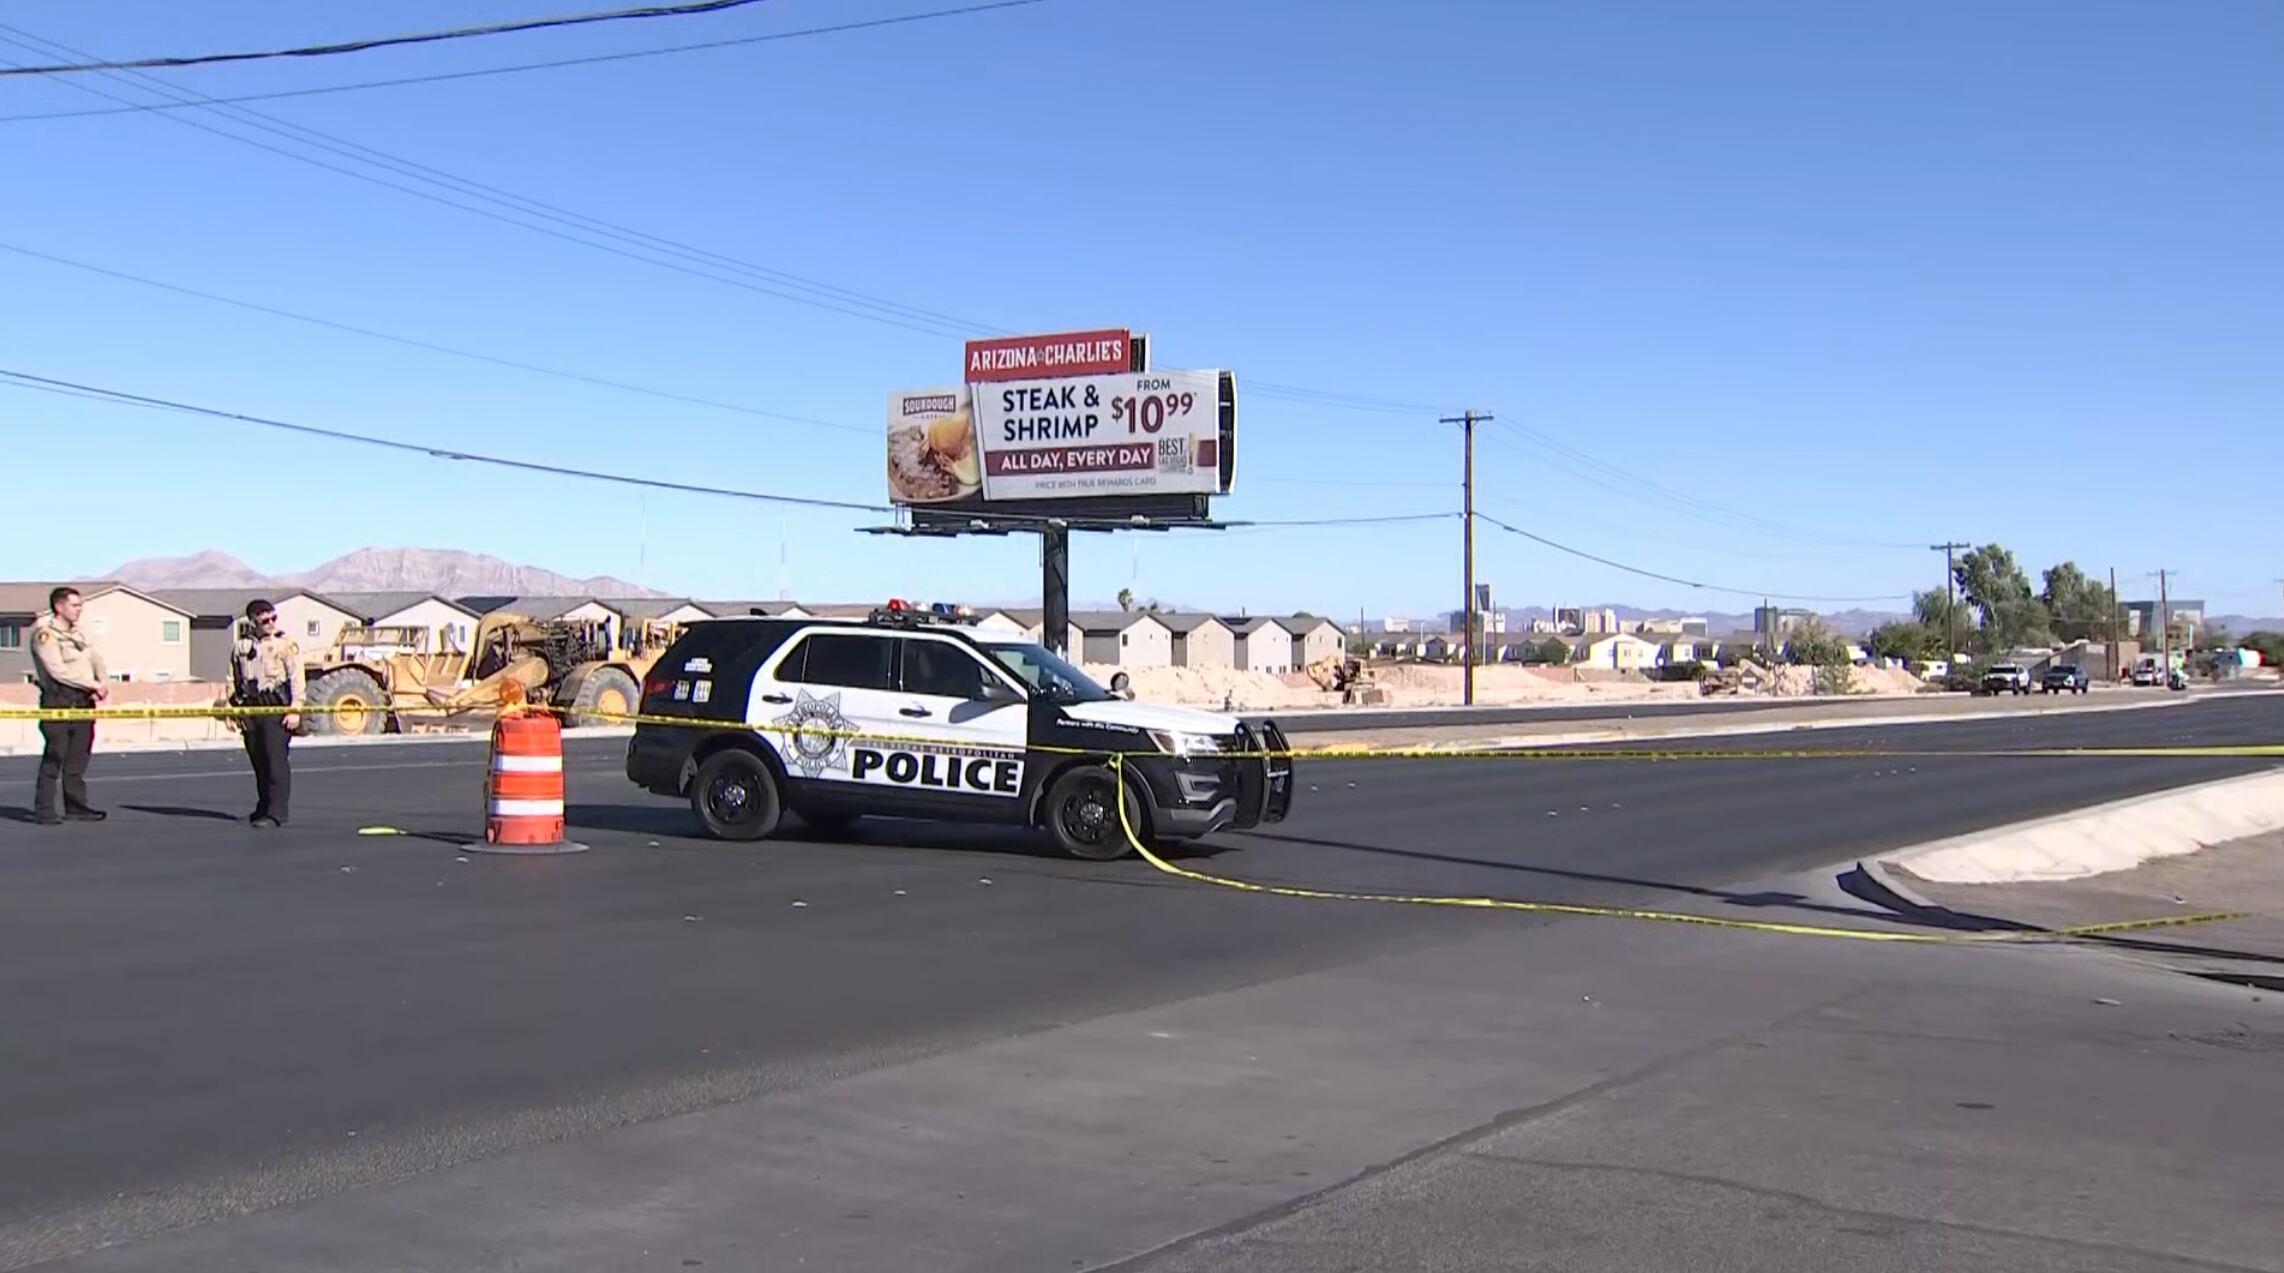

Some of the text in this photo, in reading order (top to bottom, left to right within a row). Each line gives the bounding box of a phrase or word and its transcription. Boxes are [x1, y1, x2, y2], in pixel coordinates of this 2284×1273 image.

[970, 337, 1123, 373] ARIZONA CHARLIE'S
[1002, 384, 1100, 413] STEAK &
[1137, 379, 1171, 392] FROM
[1004, 414, 1099, 442] SHRIMP
[1158, 437, 1185, 456] BEST
[1001, 447, 1151, 473] ALL DAY, EVERY DAY
[1035, 481, 1056, 489] PRICE
[1097, 478, 1133, 487] REWARDS
[1134, 477, 1156, 486] CARD
[930, 745, 1015, 760] METROPOLITAN
[852, 748, 1018, 793] POLICE
